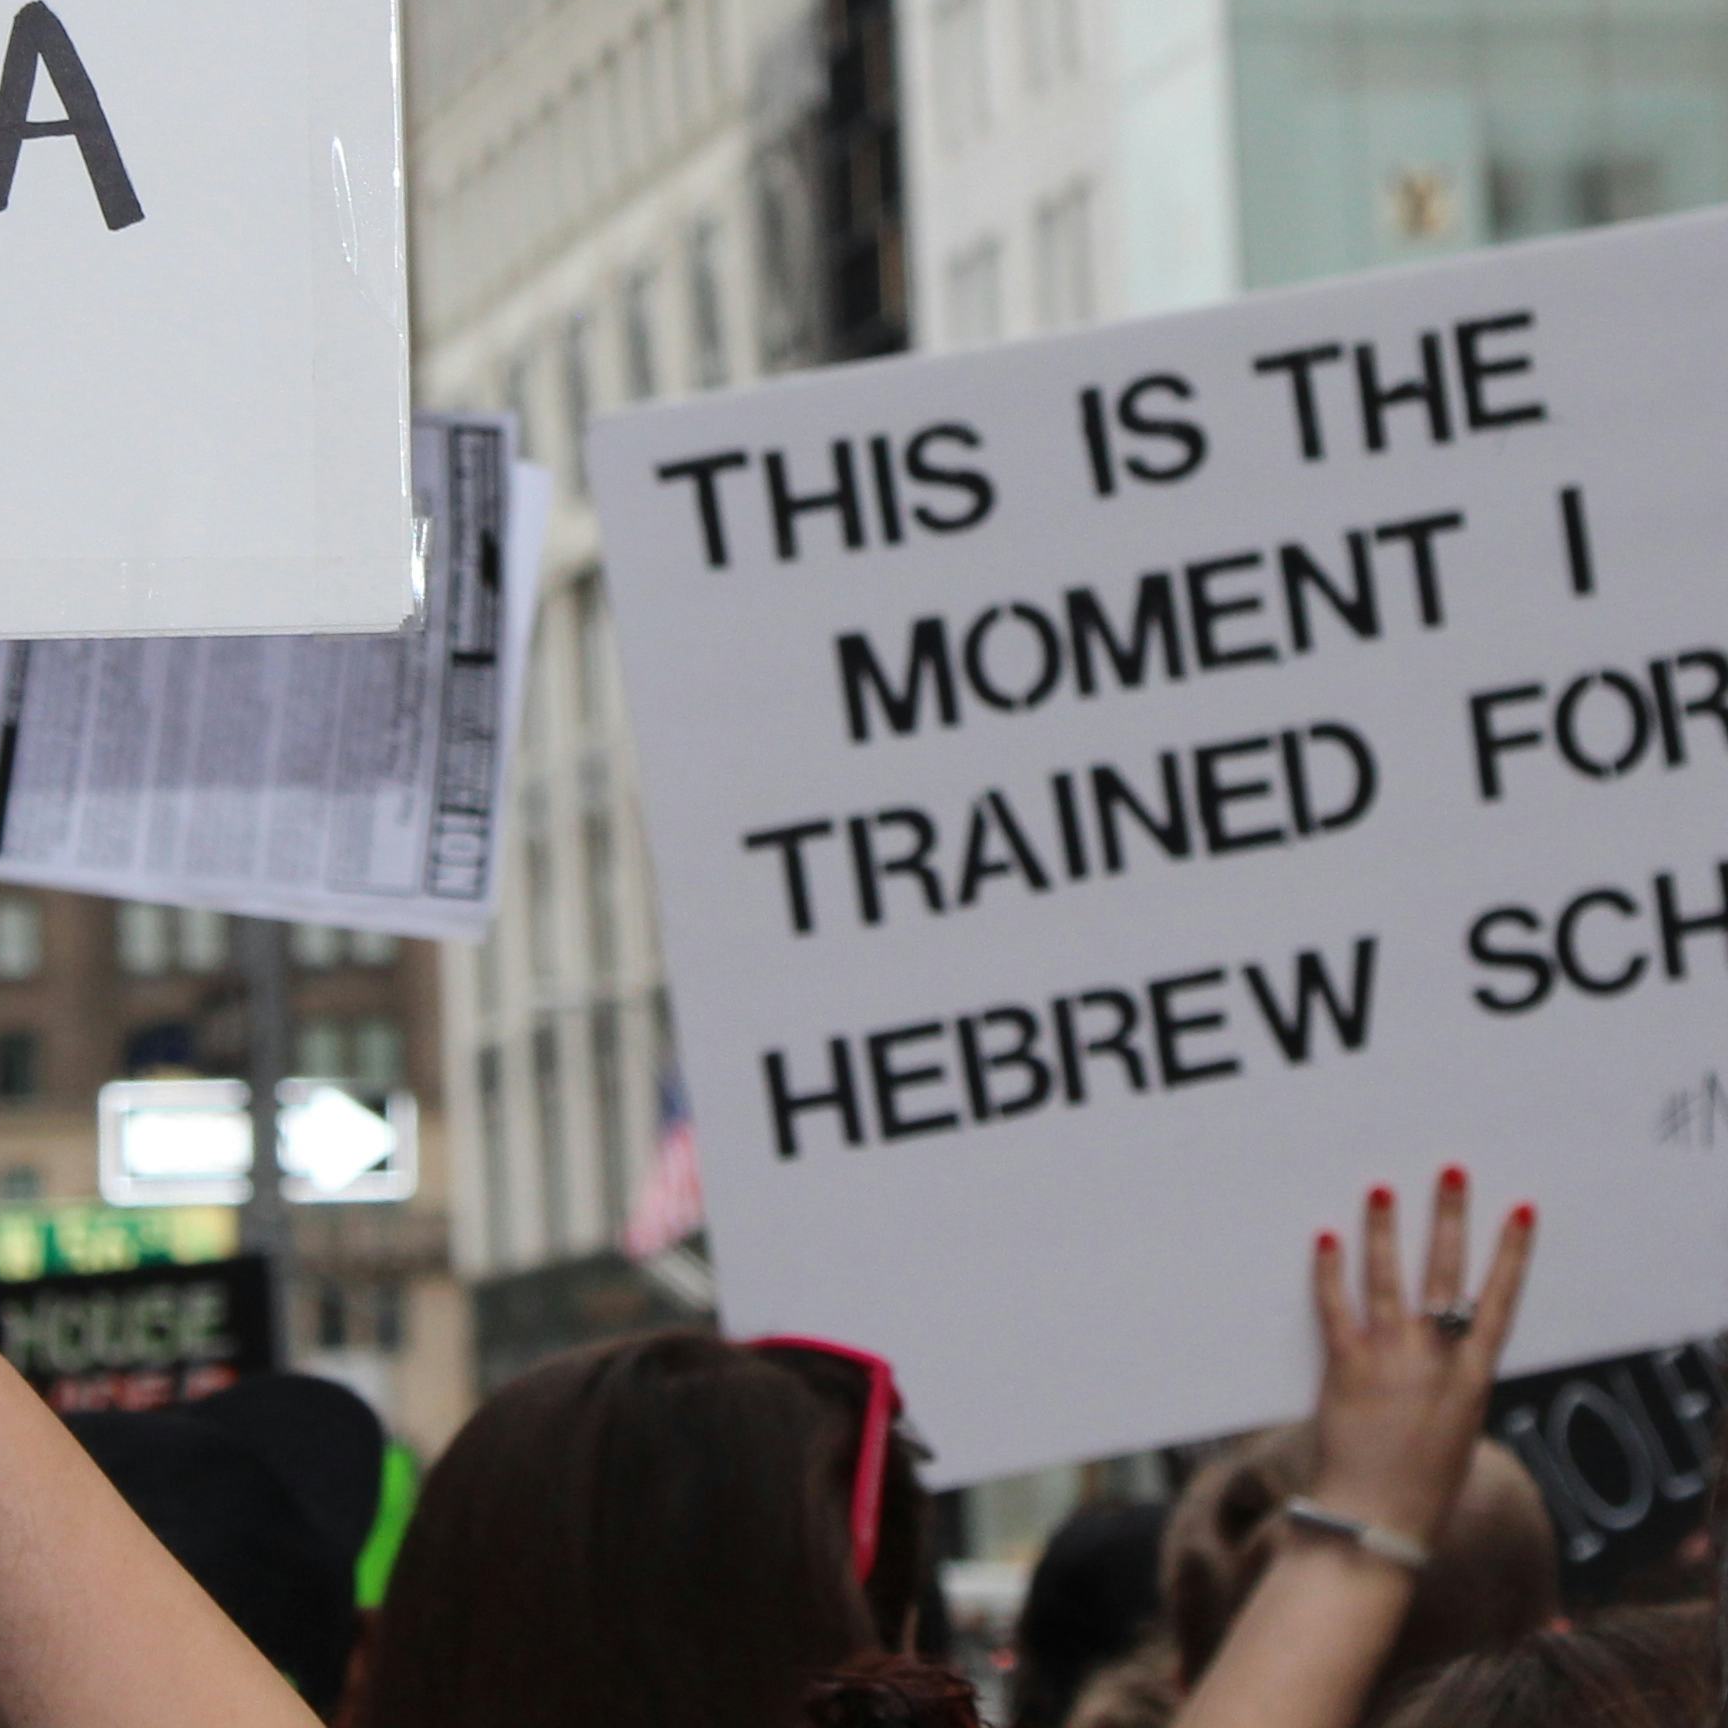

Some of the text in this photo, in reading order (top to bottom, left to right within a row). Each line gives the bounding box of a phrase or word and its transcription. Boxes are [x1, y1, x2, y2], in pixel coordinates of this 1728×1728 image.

[656, 309, 1548, 571] THIS IS THE
[835, 485, 1595, 746] MOMENT I
[742, 720, 1380, 939] TRAINED
[762, 935, 1379, 1162] HEBREW
